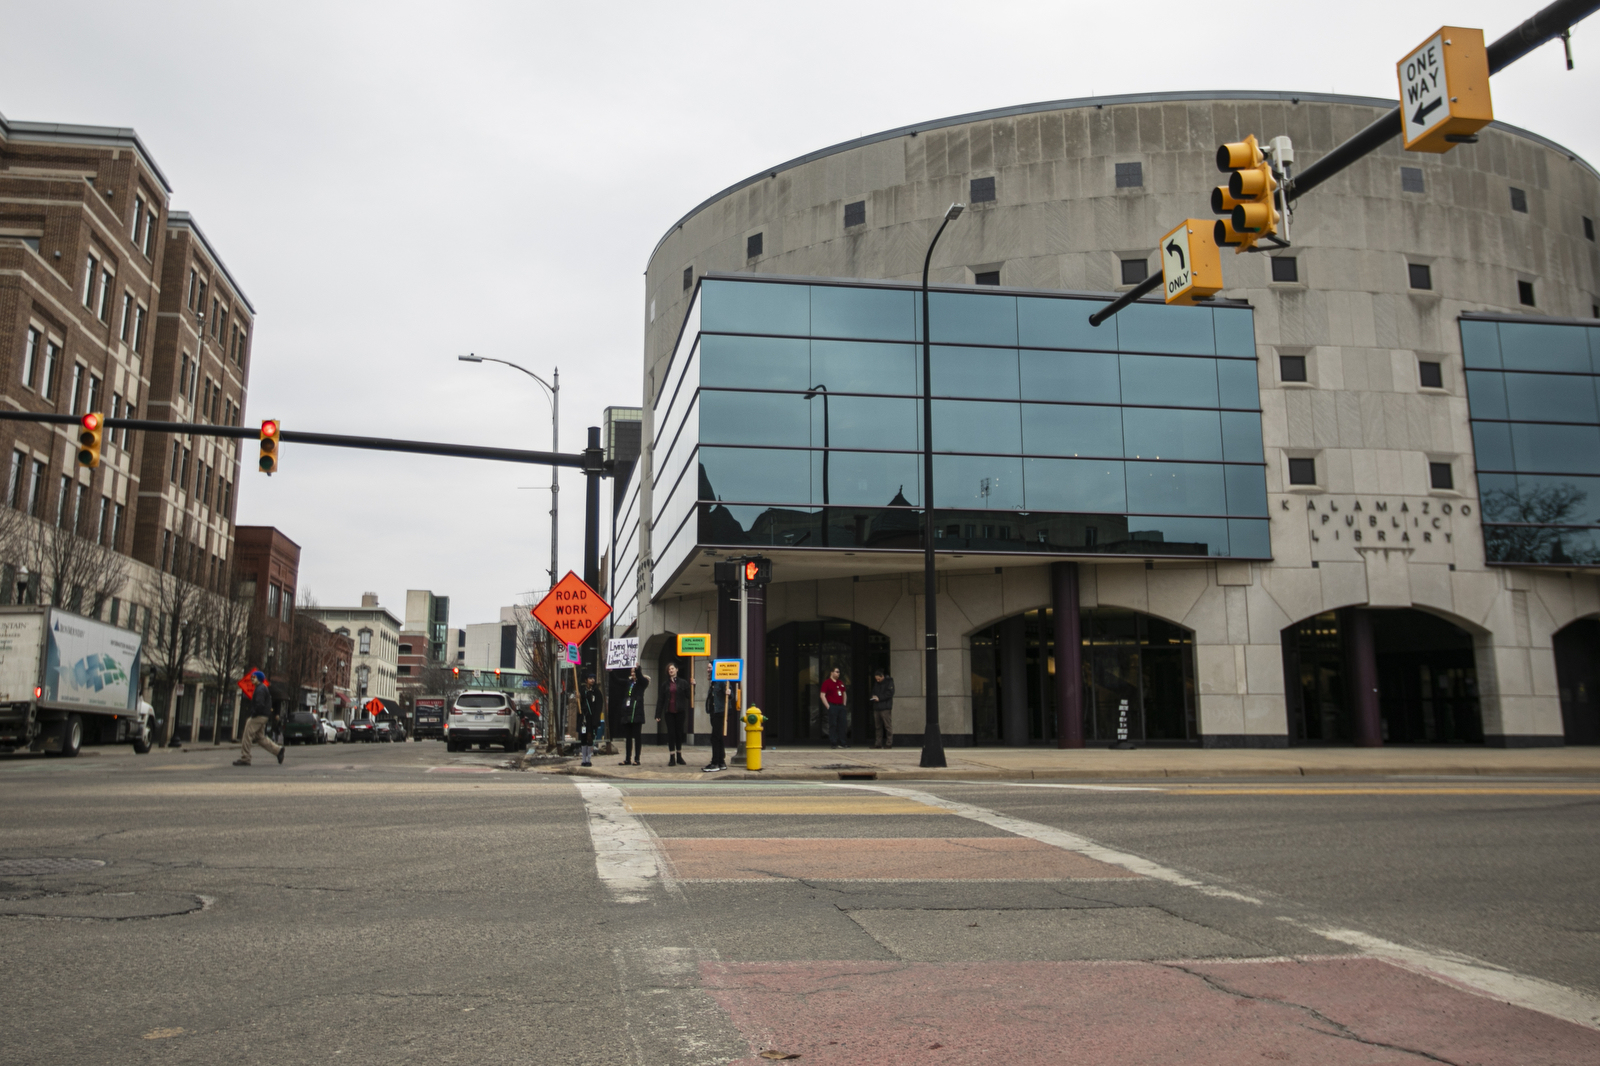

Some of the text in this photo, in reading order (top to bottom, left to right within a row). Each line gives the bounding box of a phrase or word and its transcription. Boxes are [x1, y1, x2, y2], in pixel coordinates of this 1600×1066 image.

[1406, 45, 1437, 82] ONE
[1407, 66, 1439, 105] WAY
[1168, 270, 1190, 293] ONLY
[1281, 500, 1472, 517] KALAMAZOO
[1321, 514, 1442, 530] PUBLIC
[1311, 529, 1453, 543] LIBRARY
[556, 590, 587, 601] ROAD
[555, 604, 588, 615] WORK
[553, 619, 593, 630] AHEAD
[610, 641, 626, 655] Living
